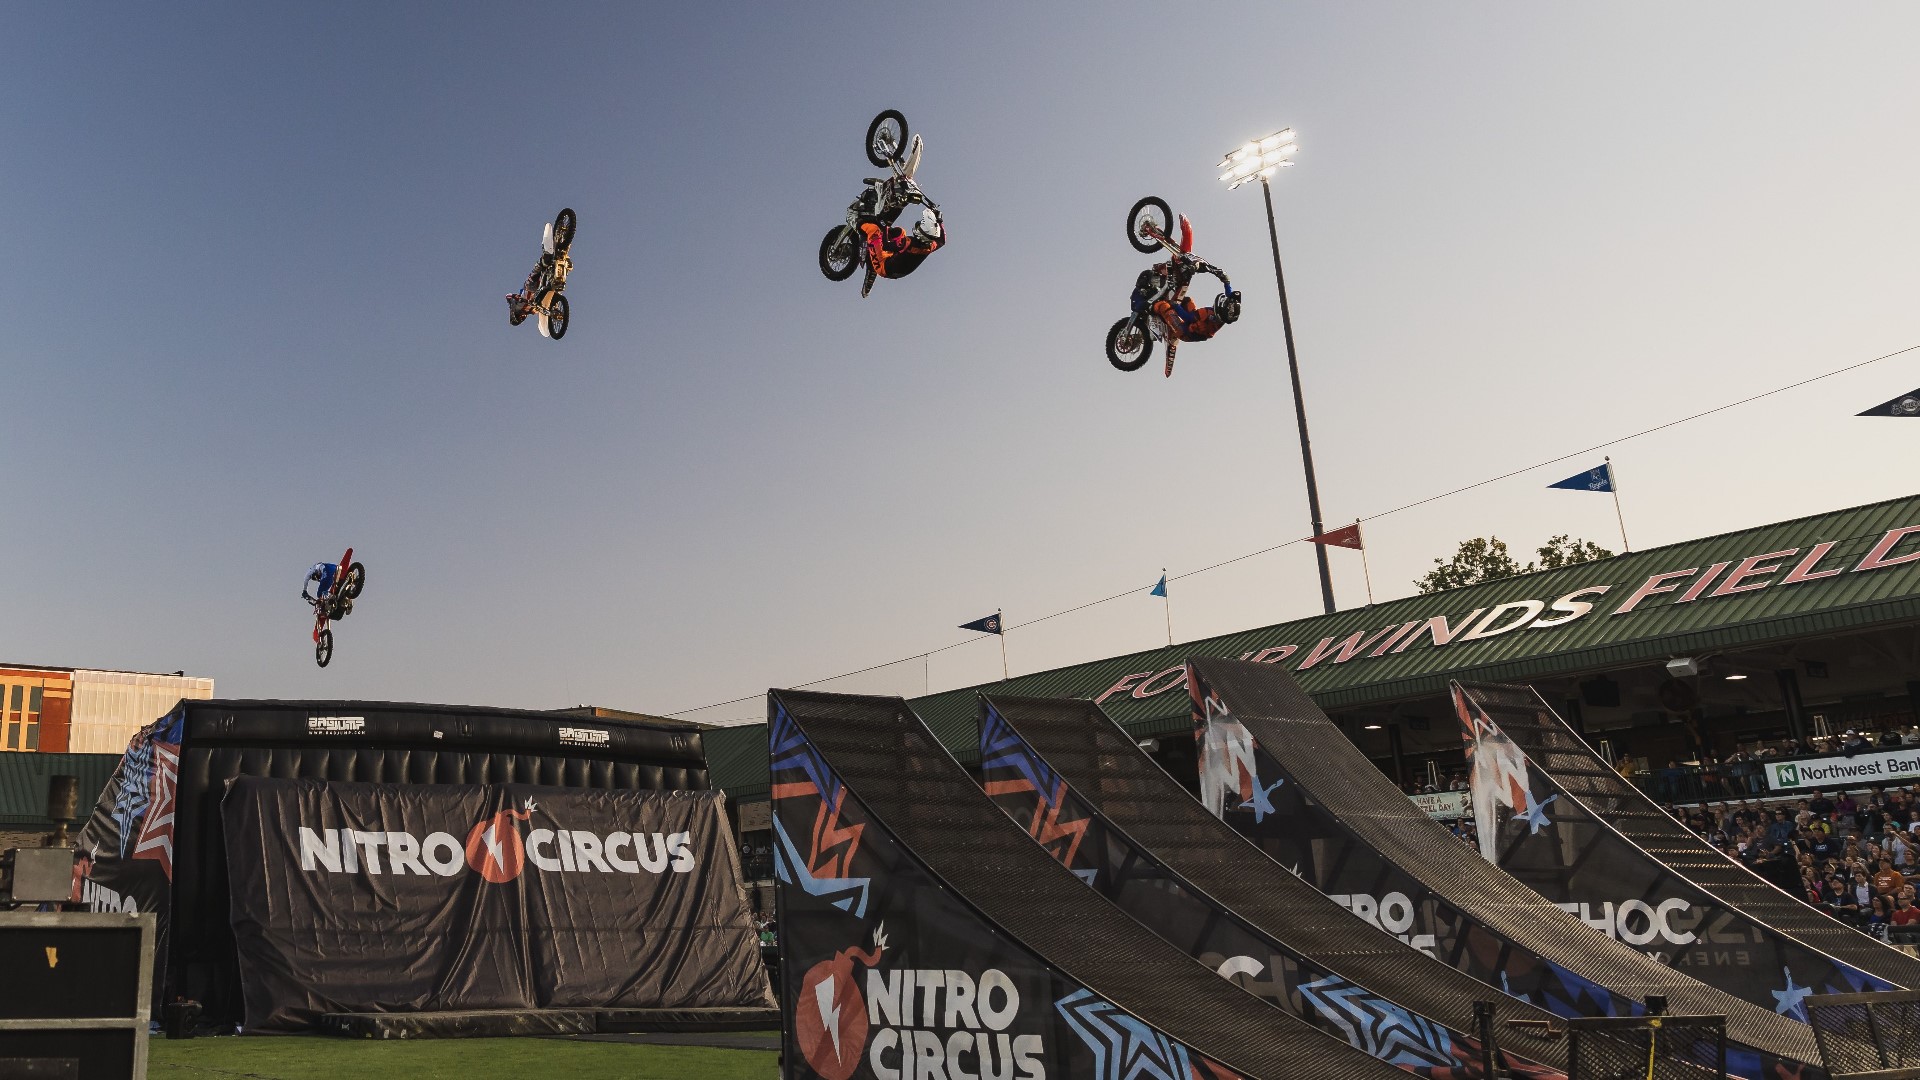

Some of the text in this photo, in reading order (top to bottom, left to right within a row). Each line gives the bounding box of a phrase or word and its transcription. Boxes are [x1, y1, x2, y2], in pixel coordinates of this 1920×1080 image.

[1297, 585, 1613, 671] WINDS
[1800, 760, 1883, 781] Northwest
[298, 826, 696, 877] NITRO CIRCUS
[866, 968, 1020, 1031] NITRO
[869, 1027, 1047, 1080] CIRCUS
